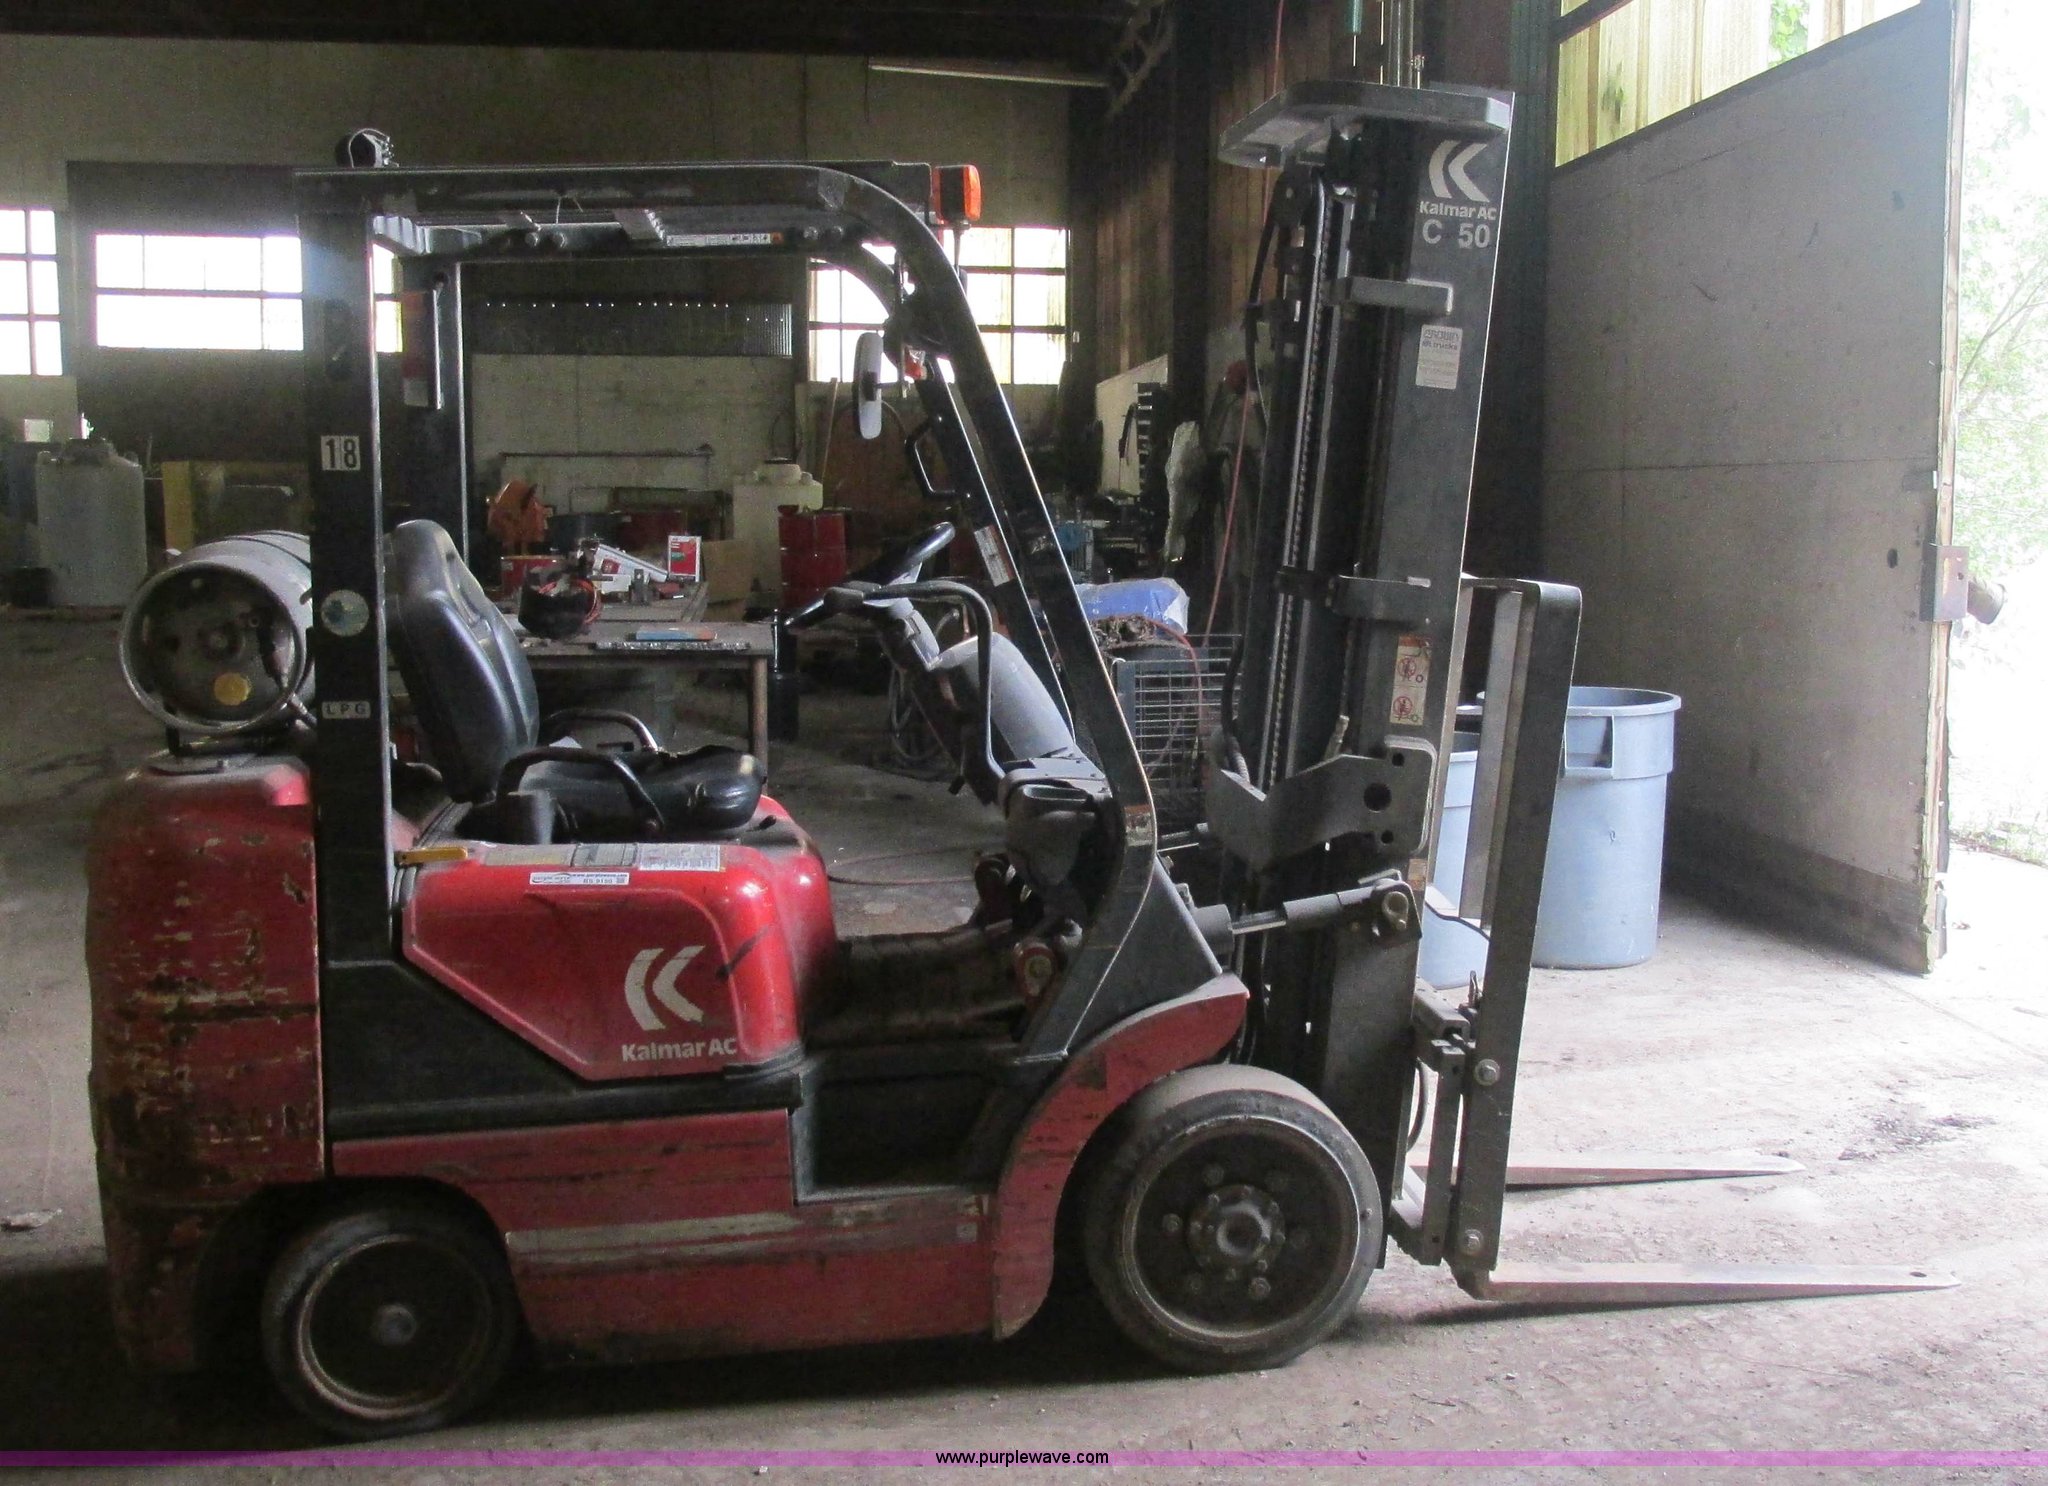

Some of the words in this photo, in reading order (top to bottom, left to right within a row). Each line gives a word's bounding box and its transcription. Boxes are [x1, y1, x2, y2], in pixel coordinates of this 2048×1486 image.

[1422, 219, 1442, 244] C
[1458, 222, 1490, 249] 50
[325, 438, 357, 468] 18
